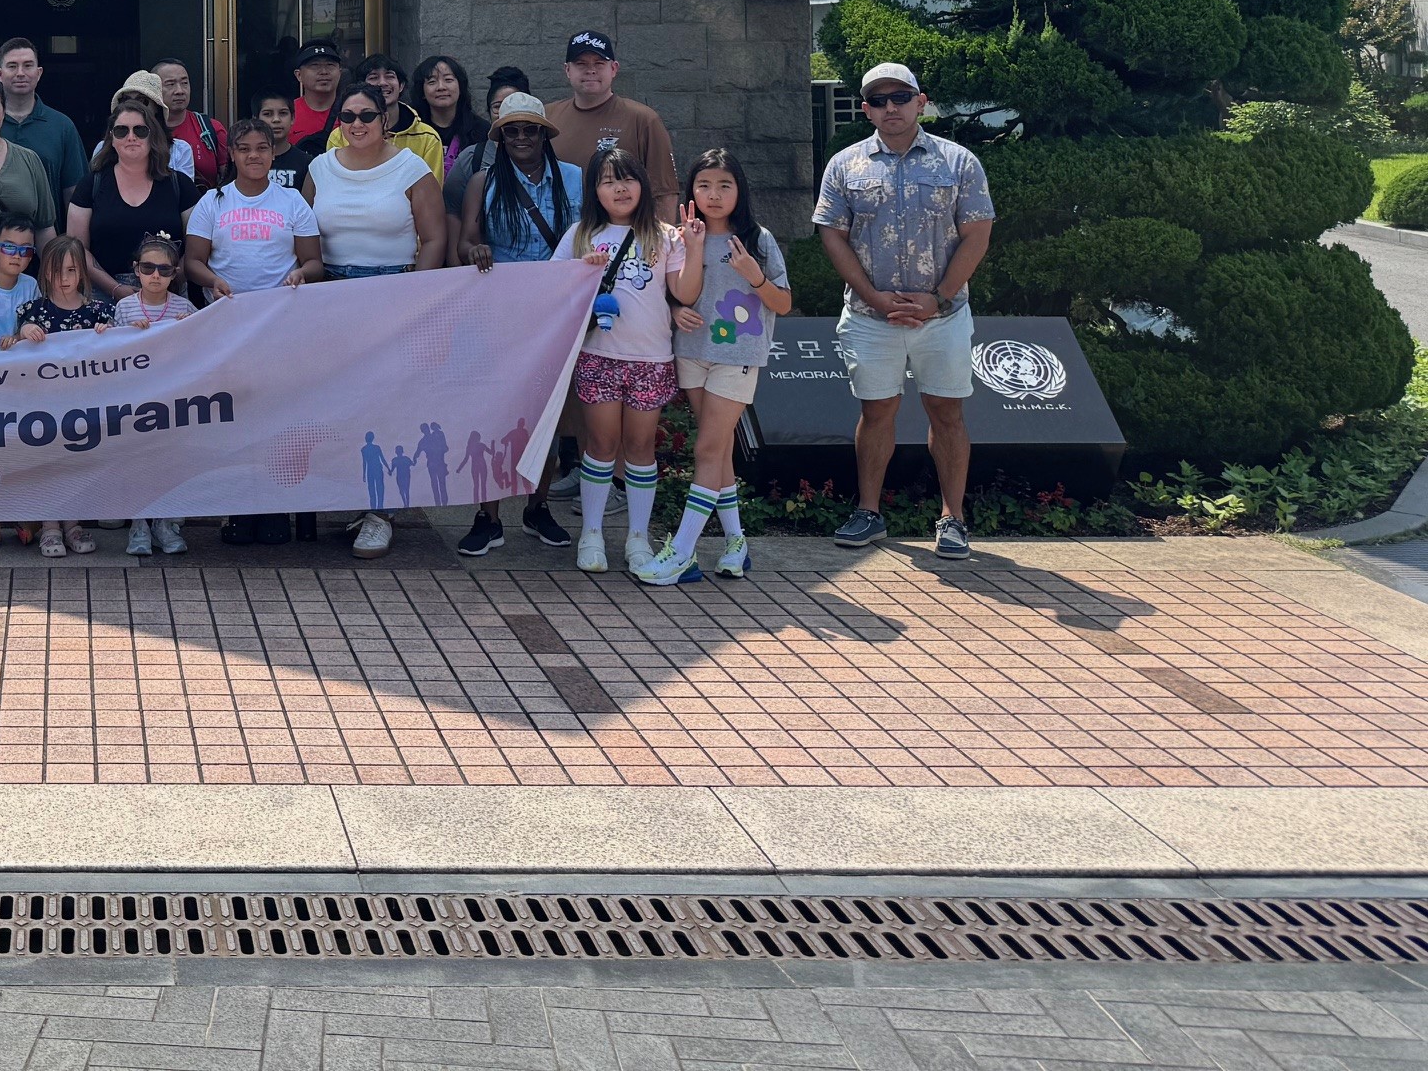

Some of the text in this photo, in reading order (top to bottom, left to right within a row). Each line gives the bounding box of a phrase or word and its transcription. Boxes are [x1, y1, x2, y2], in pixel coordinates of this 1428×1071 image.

[267, 169, 297, 187] AST
[219, 207, 285, 229] KINDNESS
[230, 223, 271, 241] CREW
[37, 353, 150, 380] Culture
[769, 371, 850, 379] MEMORIAL
